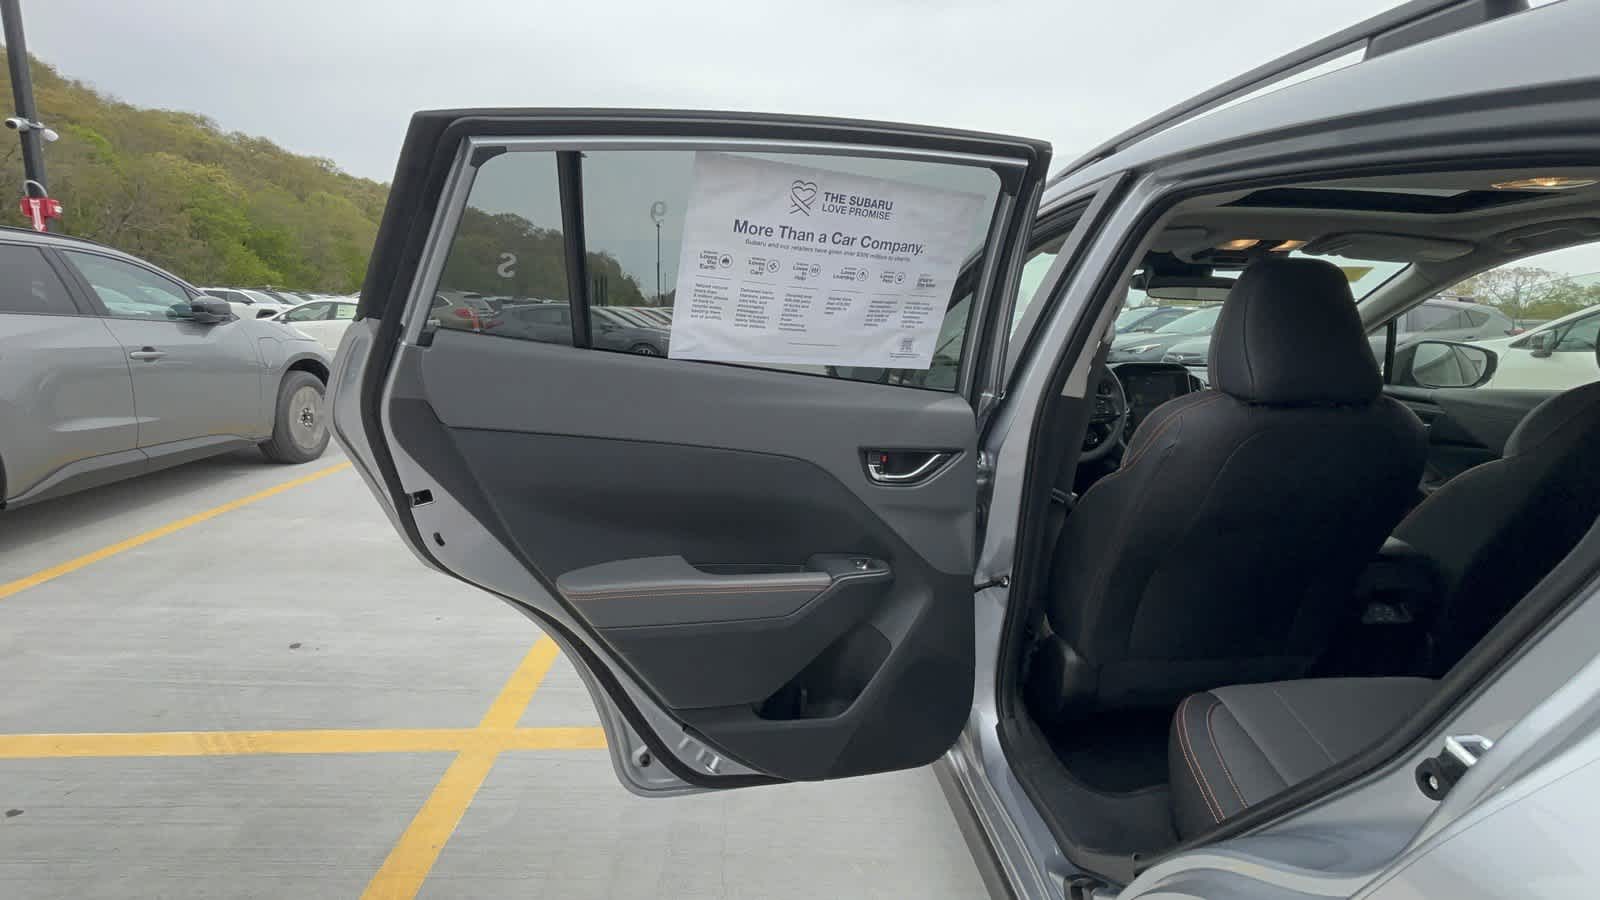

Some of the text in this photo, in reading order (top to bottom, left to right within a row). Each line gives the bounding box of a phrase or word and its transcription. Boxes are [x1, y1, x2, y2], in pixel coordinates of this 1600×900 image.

[824, 192, 893, 210] THE SUBARU
[822, 203, 891, 220] LOVE PROMISE
[733, 219, 774, 237] More
[779, 225, 815, 242] Than
[818, 232, 828, 243] a
[831, 231, 857, 246] Car
[860, 235, 924, 256] Company.
